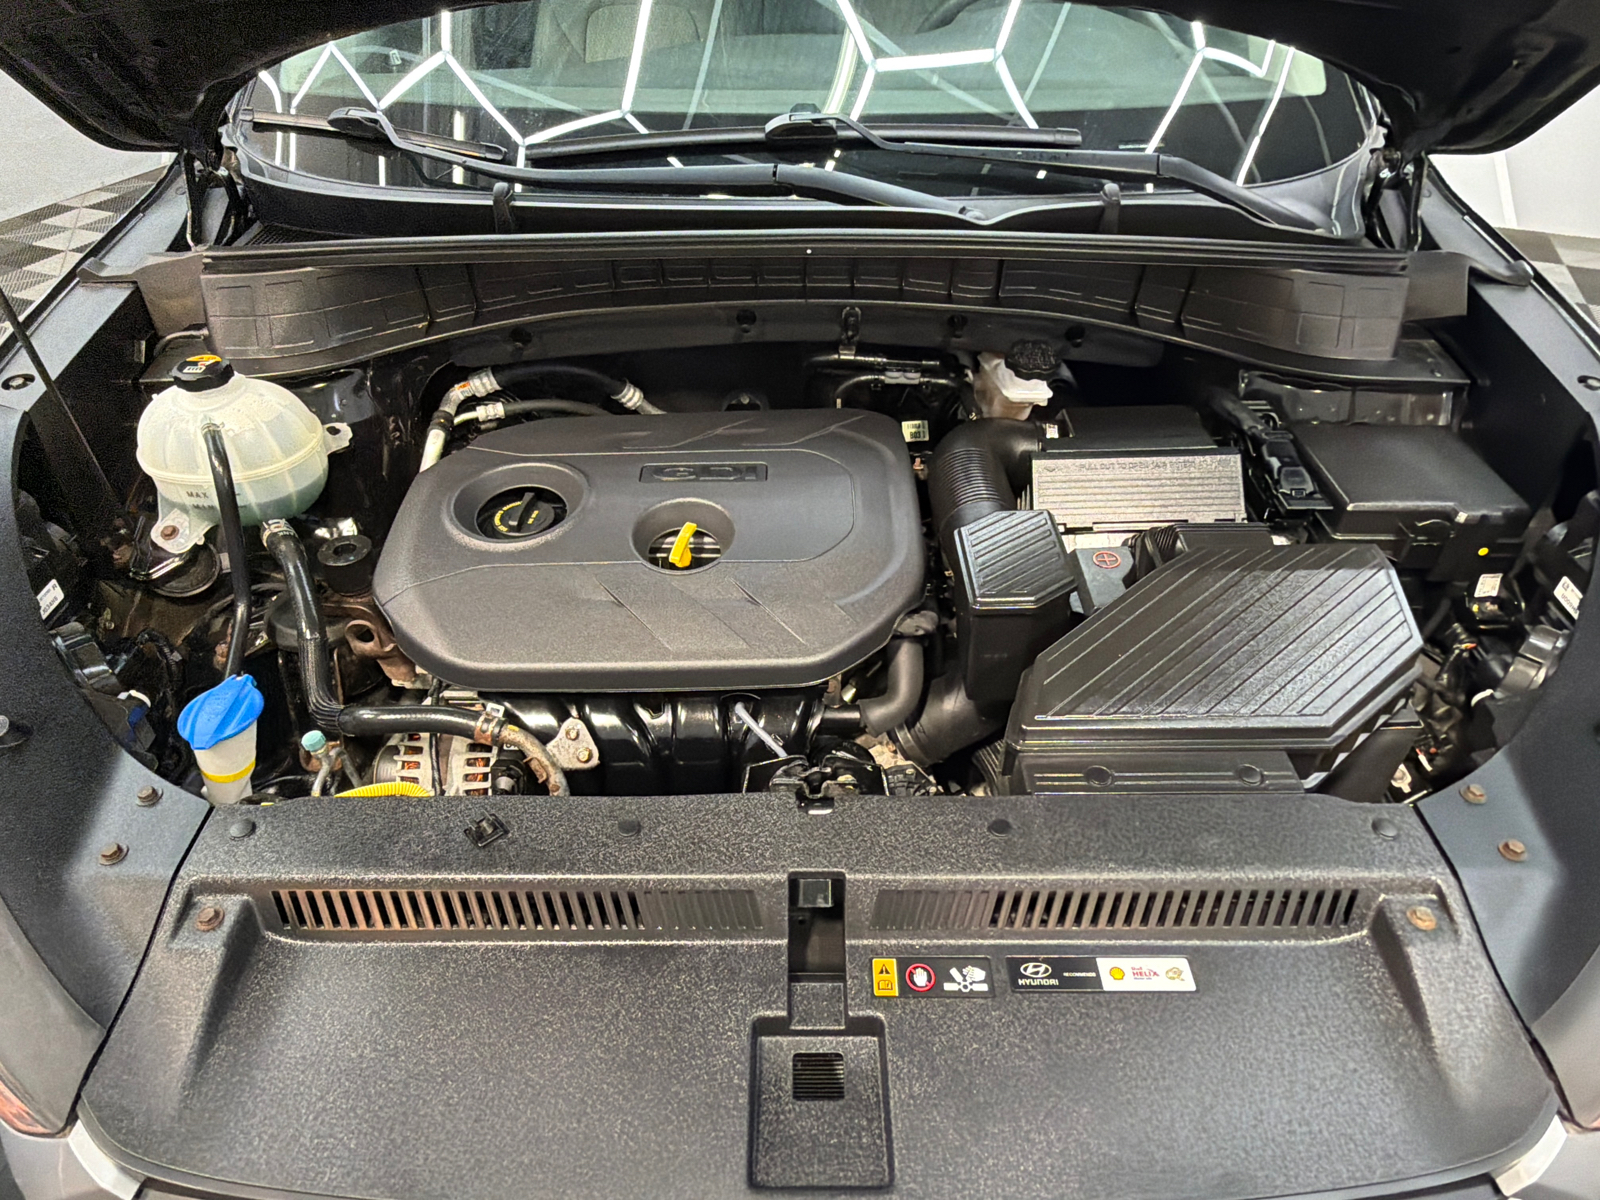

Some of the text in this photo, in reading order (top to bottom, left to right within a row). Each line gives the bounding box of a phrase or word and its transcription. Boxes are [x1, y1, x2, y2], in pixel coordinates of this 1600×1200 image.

[1100, 462, 1115, 470] OUT
[1116, 462, 1127, 470] TO
[186, 491, 209, 499] MAX
[1132, 969, 1160, 977] HELIX
[1018, 978, 1059, 986] HYUNDAI
